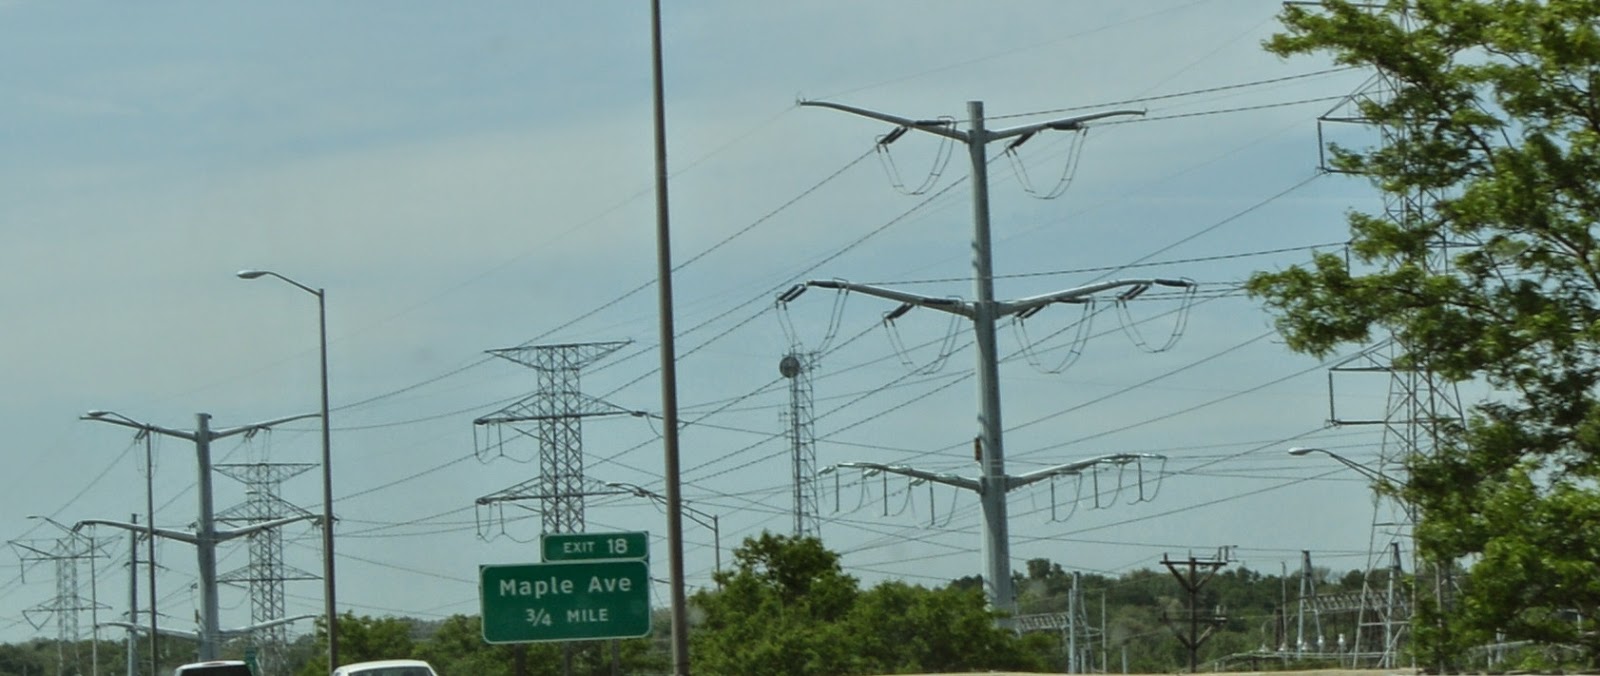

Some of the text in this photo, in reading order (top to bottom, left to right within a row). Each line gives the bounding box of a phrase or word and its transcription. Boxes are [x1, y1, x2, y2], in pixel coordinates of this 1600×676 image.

[563, 538, 628, 554] EXIT 18
[500, 576, 632, 599] Maple Ave
[566, 608, 609, 623] MILE
